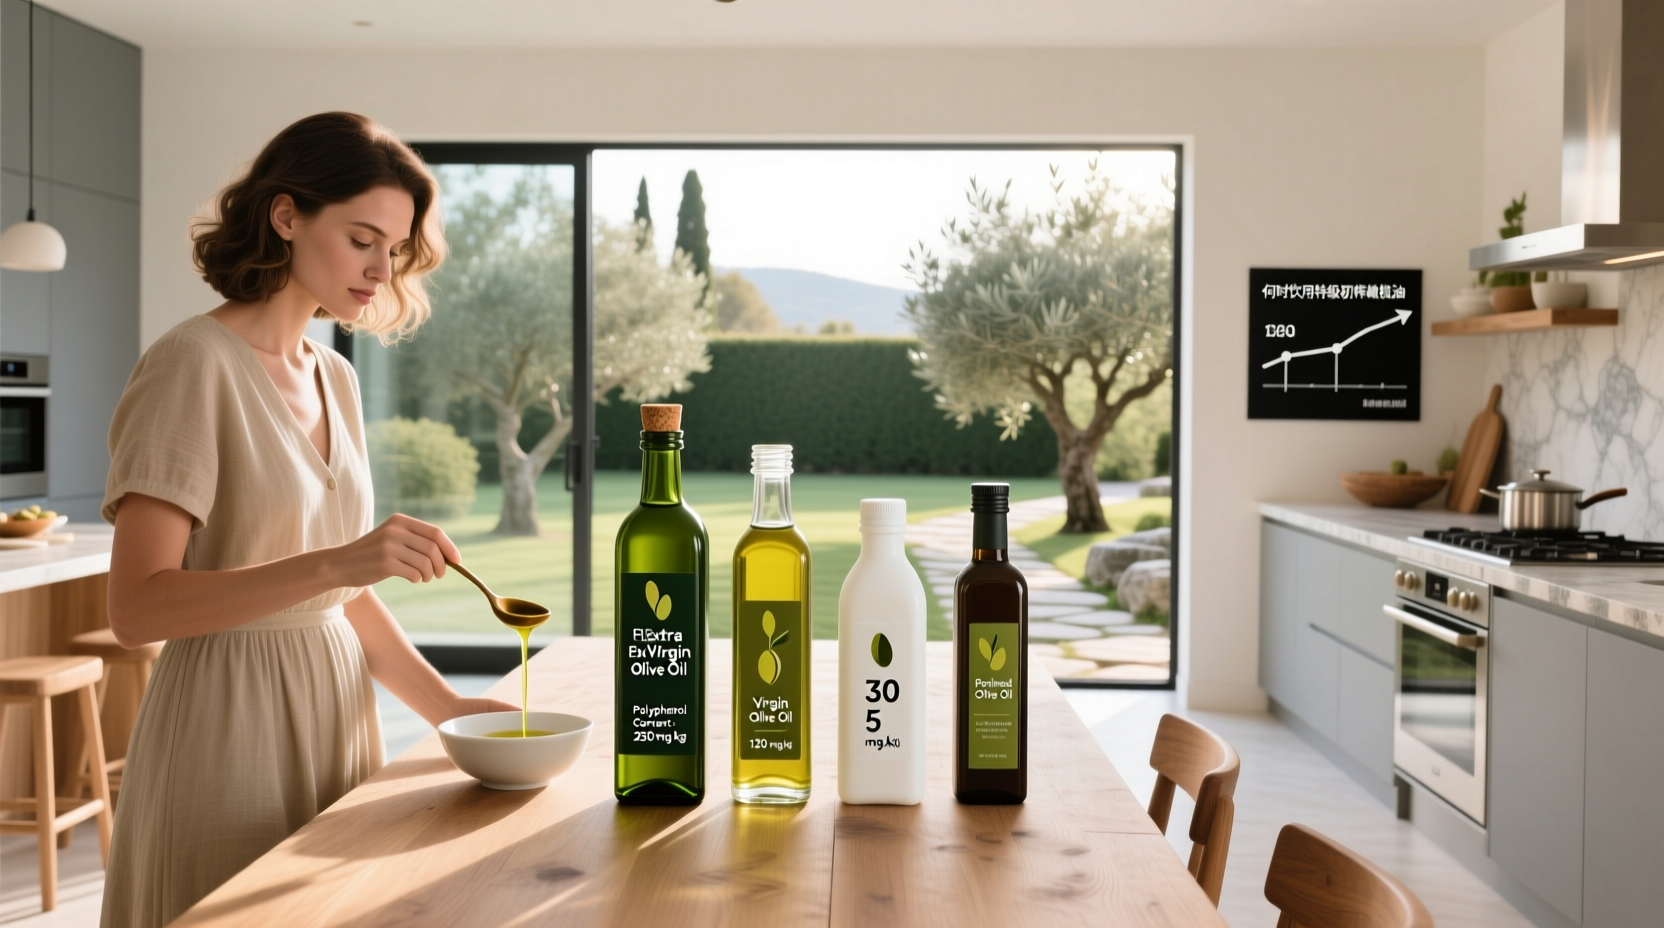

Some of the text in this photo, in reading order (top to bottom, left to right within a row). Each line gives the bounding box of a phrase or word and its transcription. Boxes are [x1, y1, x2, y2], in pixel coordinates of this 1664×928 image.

[630, 661, 688, 677] Olive Oil
[865, 678, 900, 704] 30
[1000, 689, 1013, 700] Oil
[752, 696, 789, 712] Virgin
[778, 711, 793, 723] Oil
[865, 709, 882, 733] 5
[749, 738, 768, 749] 120
